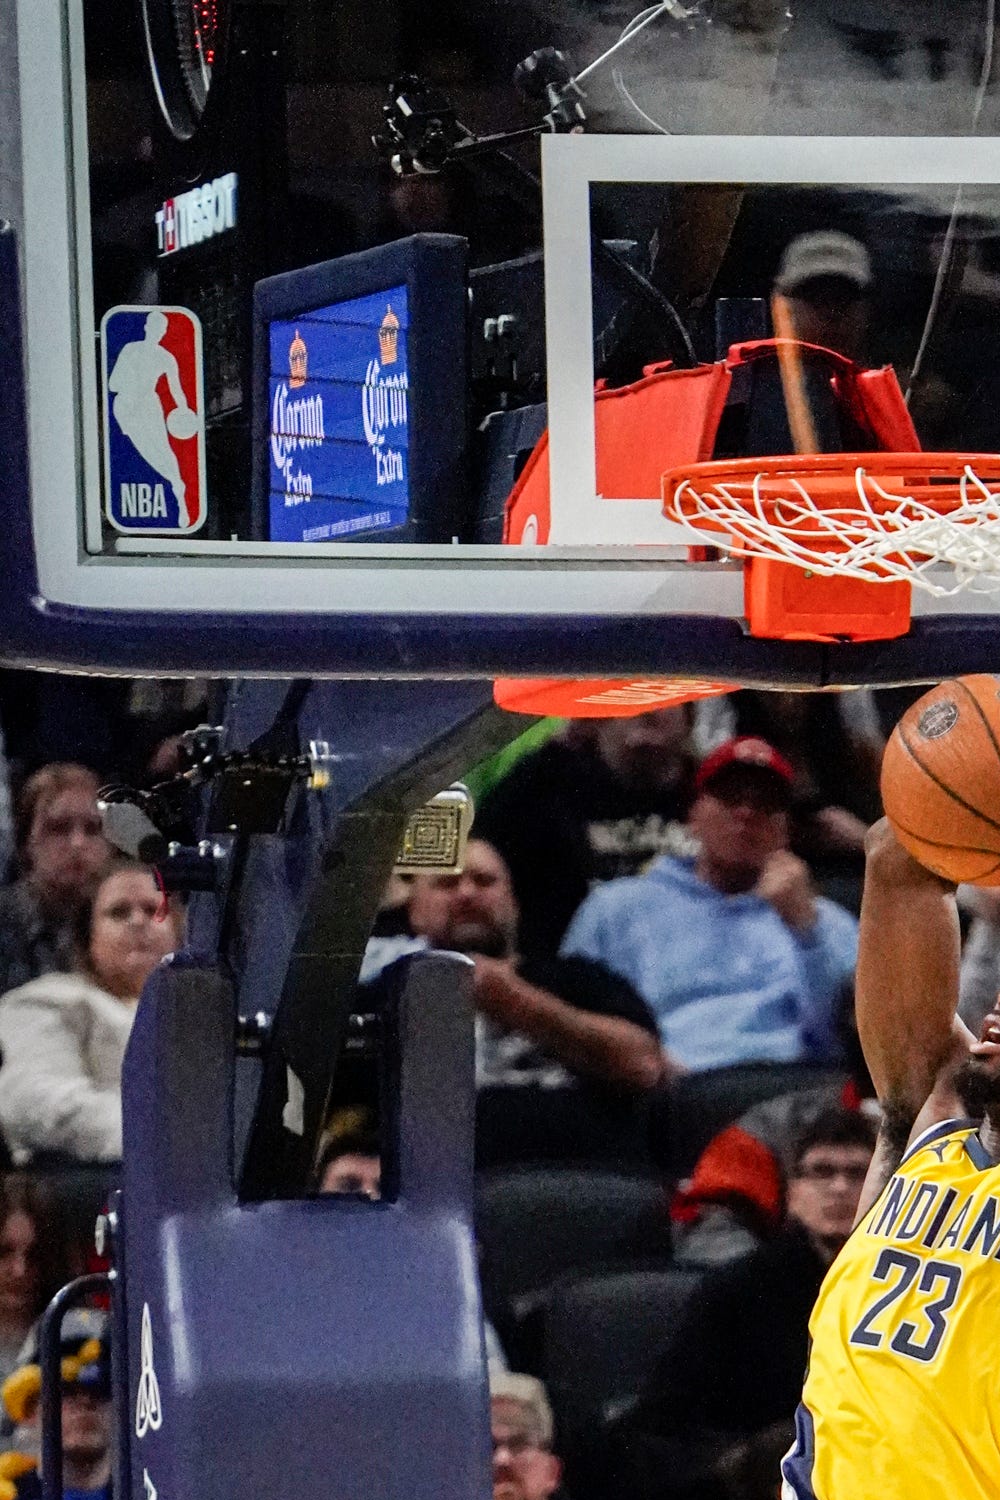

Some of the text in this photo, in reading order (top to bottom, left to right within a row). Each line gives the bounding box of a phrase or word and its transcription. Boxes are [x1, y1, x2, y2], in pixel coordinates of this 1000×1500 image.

[271, 383, 325, 469] Corona
[121, 483, 168, 518] NBA
[848, 1246, 963, 1364] 23
